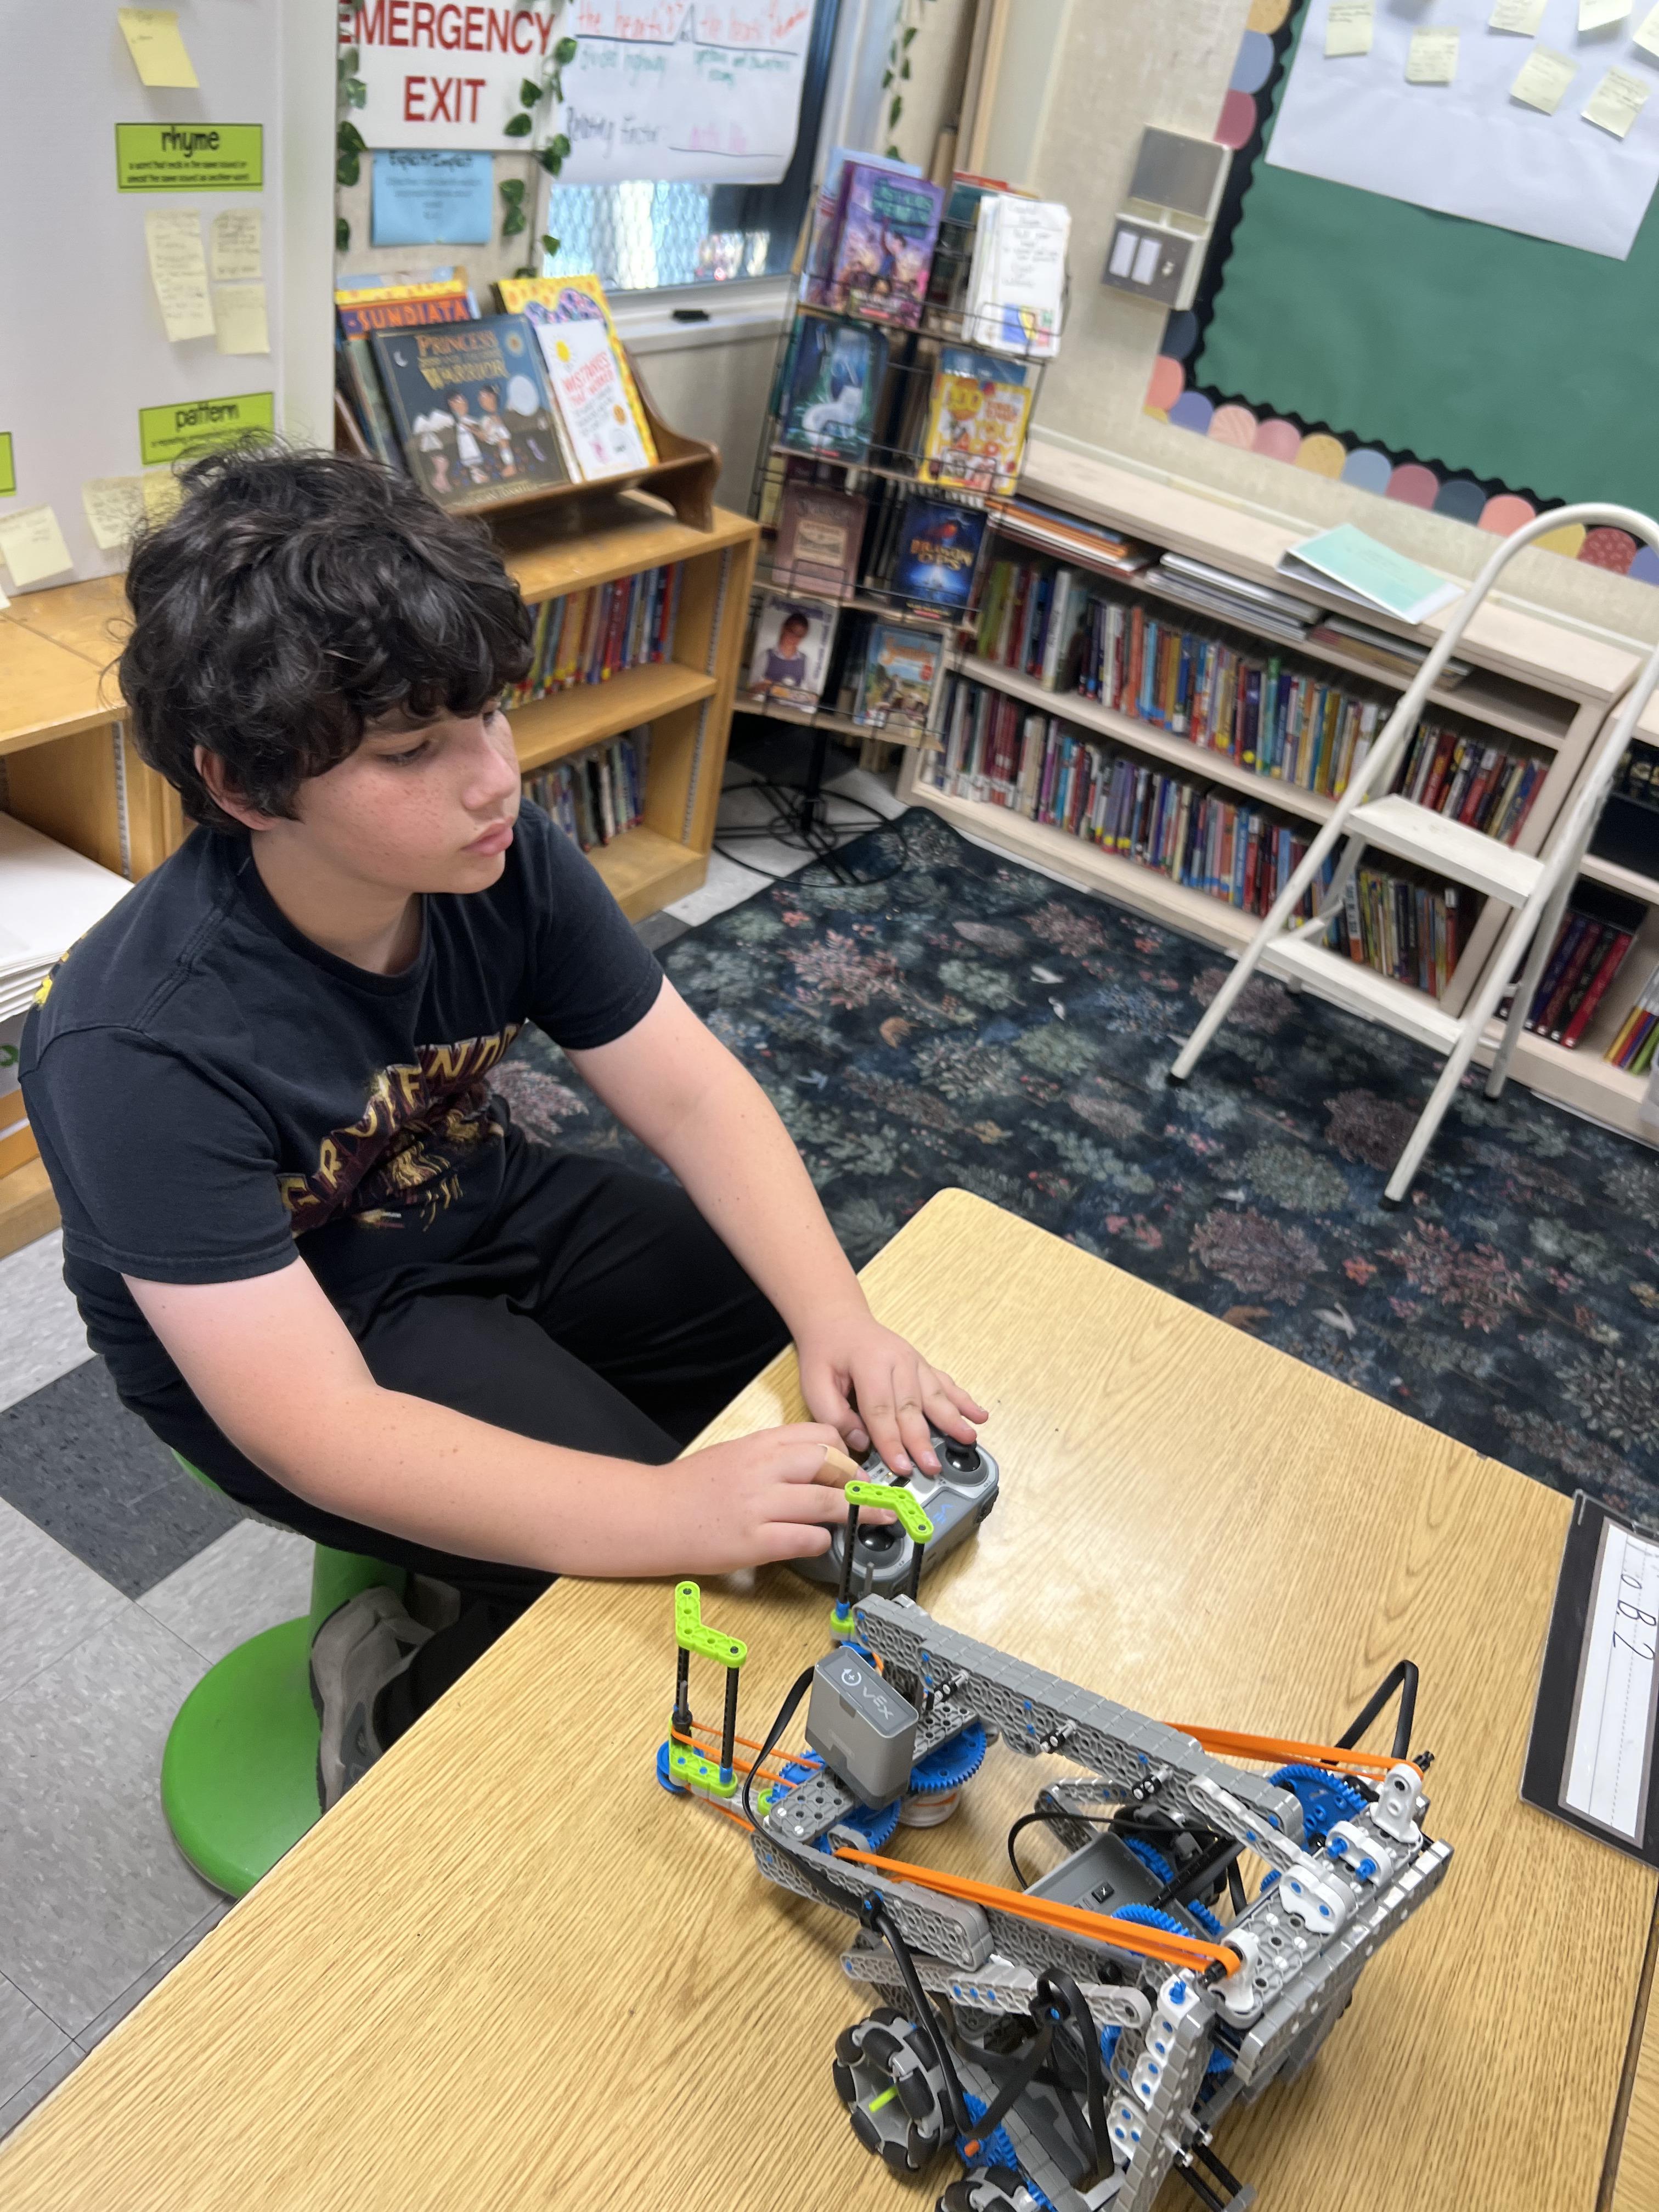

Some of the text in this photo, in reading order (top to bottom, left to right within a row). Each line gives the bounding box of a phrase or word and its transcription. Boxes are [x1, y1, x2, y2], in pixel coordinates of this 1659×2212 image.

[338, 0, 555, 55] EMERGENCY
[404, 76, 486, 123] EXIT
[161, 126, 220, 158] rhyme
[357, 299, 471, 331] SUNDIATA
[175, 401, 240, 432] pattern
[933, 1504, 955, 1525] VE
[863, 1686, 895, 1720] VEX
